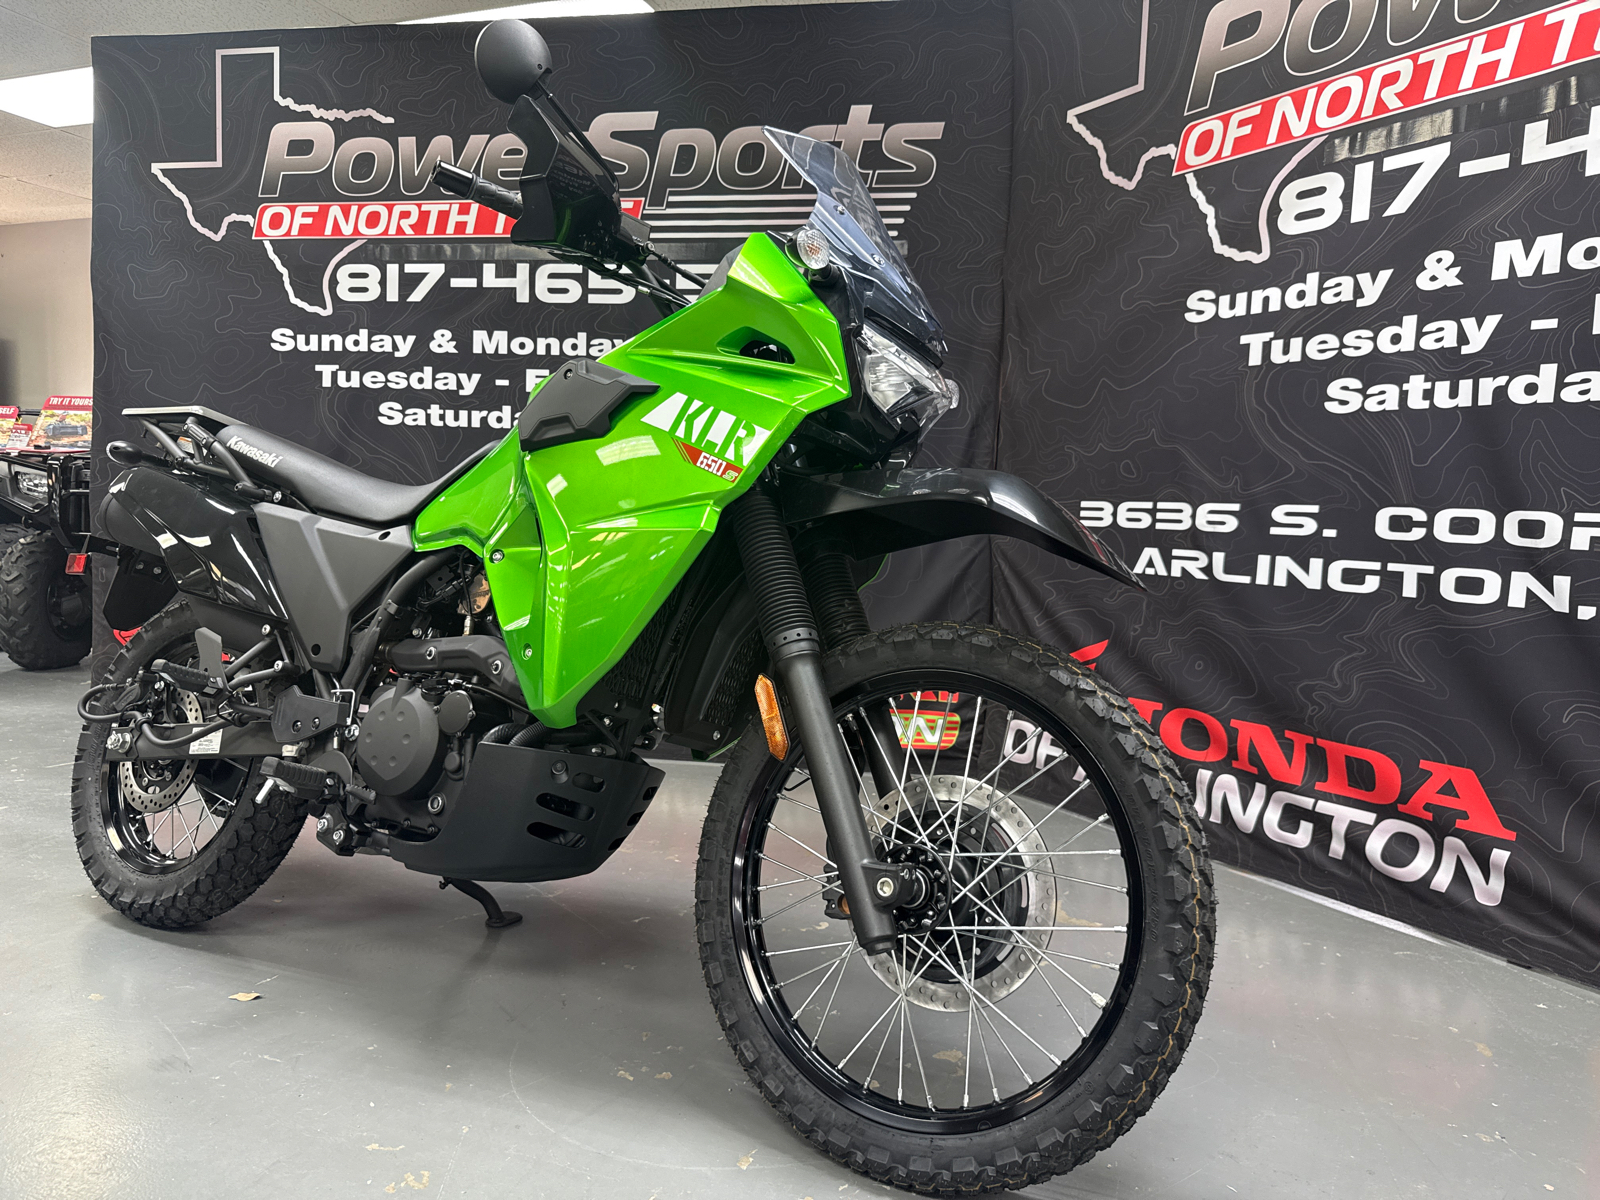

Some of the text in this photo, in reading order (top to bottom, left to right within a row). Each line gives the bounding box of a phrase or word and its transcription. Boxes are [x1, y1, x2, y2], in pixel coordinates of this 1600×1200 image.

[1184, 105, 1262, 167] OF
[1266, 21, 1525, 144] NORTH
[258, 104, 946, 210] PoweSports
[261, 205, 320, 236] OF
[323, 201, 478, 237] NORTH
[1184, 267, 1394, 324] Sunday
[1415, 249, 1464, 291] &
[270, 328, 627, 358] Sunday & Monda
[1240, 313, 1503, 367] Tuesday
[314, 364, 480, 394] Tuesday
[49, 397, 63, 405] TRY
[63, 397, 71, 405] IT
[378, 402, 522, 430] Saturd
[652, 392, 768, 467] KLR
[226, 435, 284, 468] Kawasaki
[696, 452, 727, 476] 650
[1078, 500, 1241, 533] 3636
[1269, 504, 1338, 538] S.
[1133, 546, 1597, 620] ARLINGTON,
